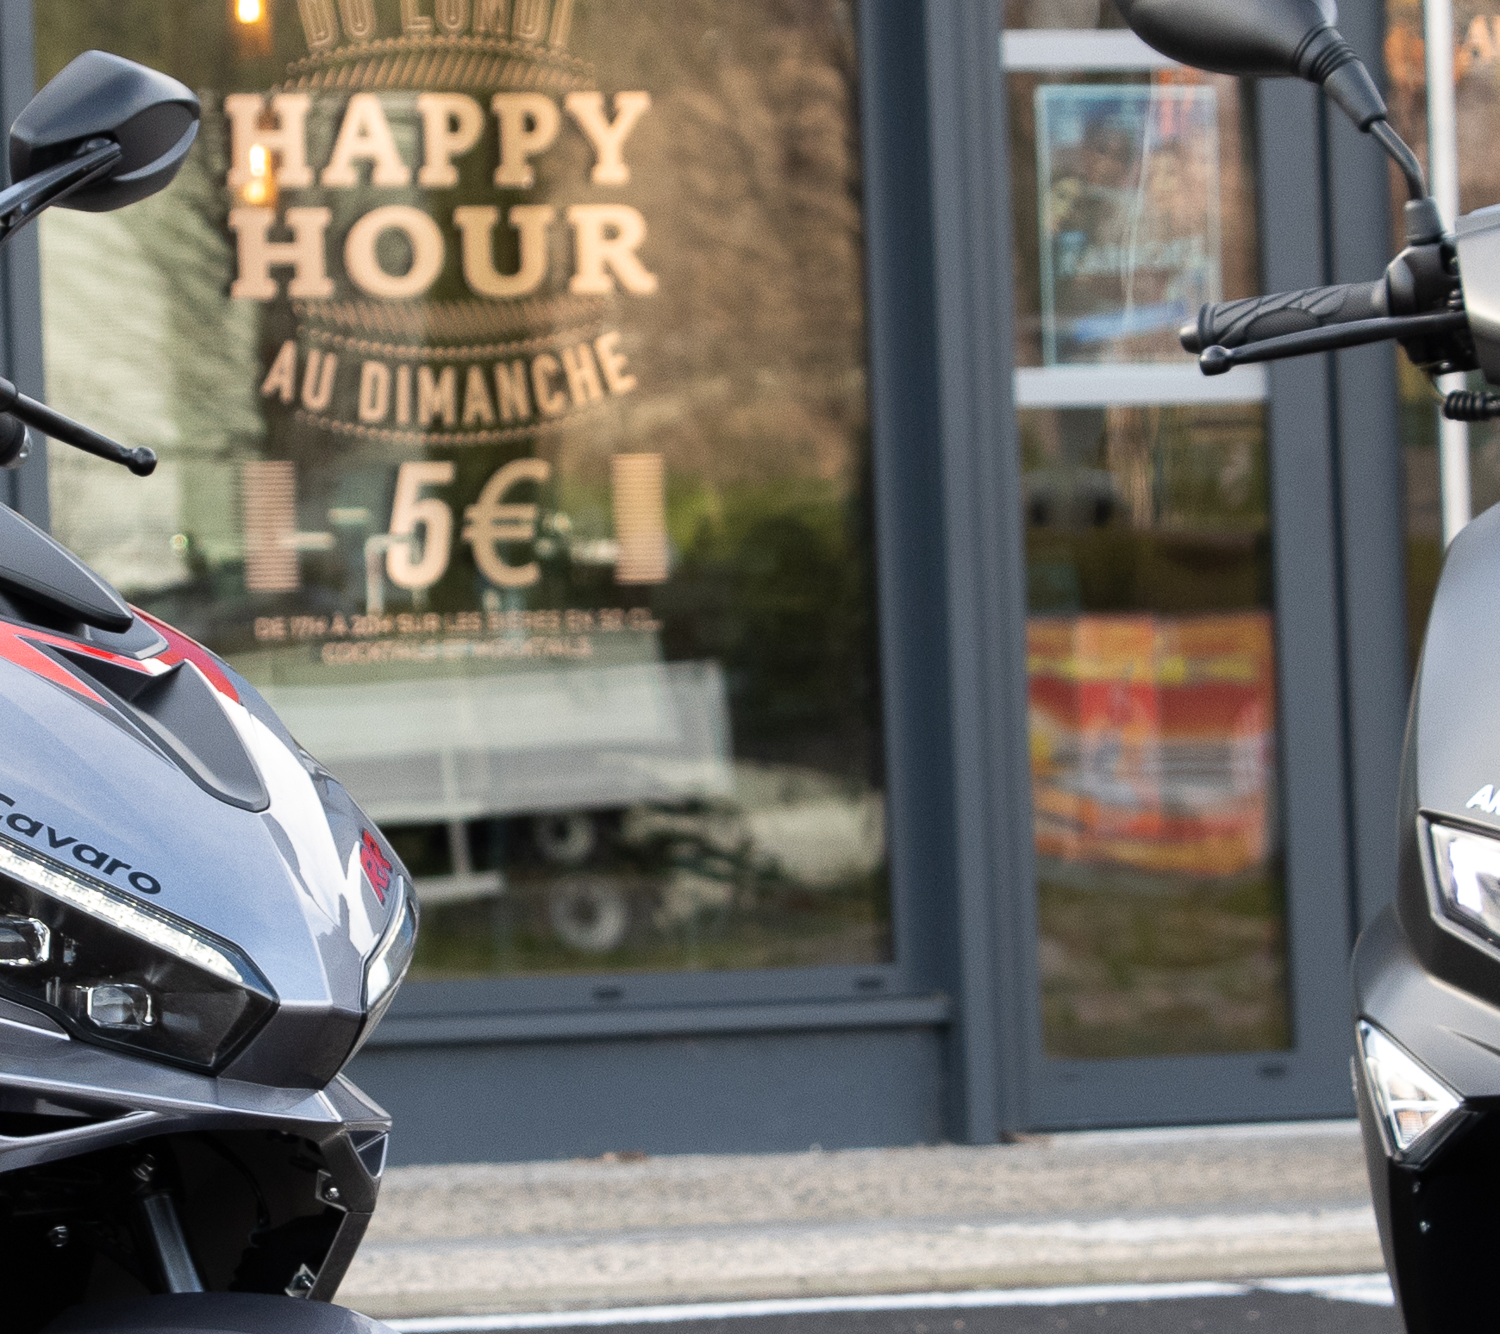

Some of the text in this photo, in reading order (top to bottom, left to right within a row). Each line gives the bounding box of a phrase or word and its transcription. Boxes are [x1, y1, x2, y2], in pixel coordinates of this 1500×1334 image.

[225, 91, 653, 189] HAPPY
[228, 203, 659, 300] HOUR
[261, 330, 638, 427] AU DIMANCHE
[385, 456, 553, 589] 5€
